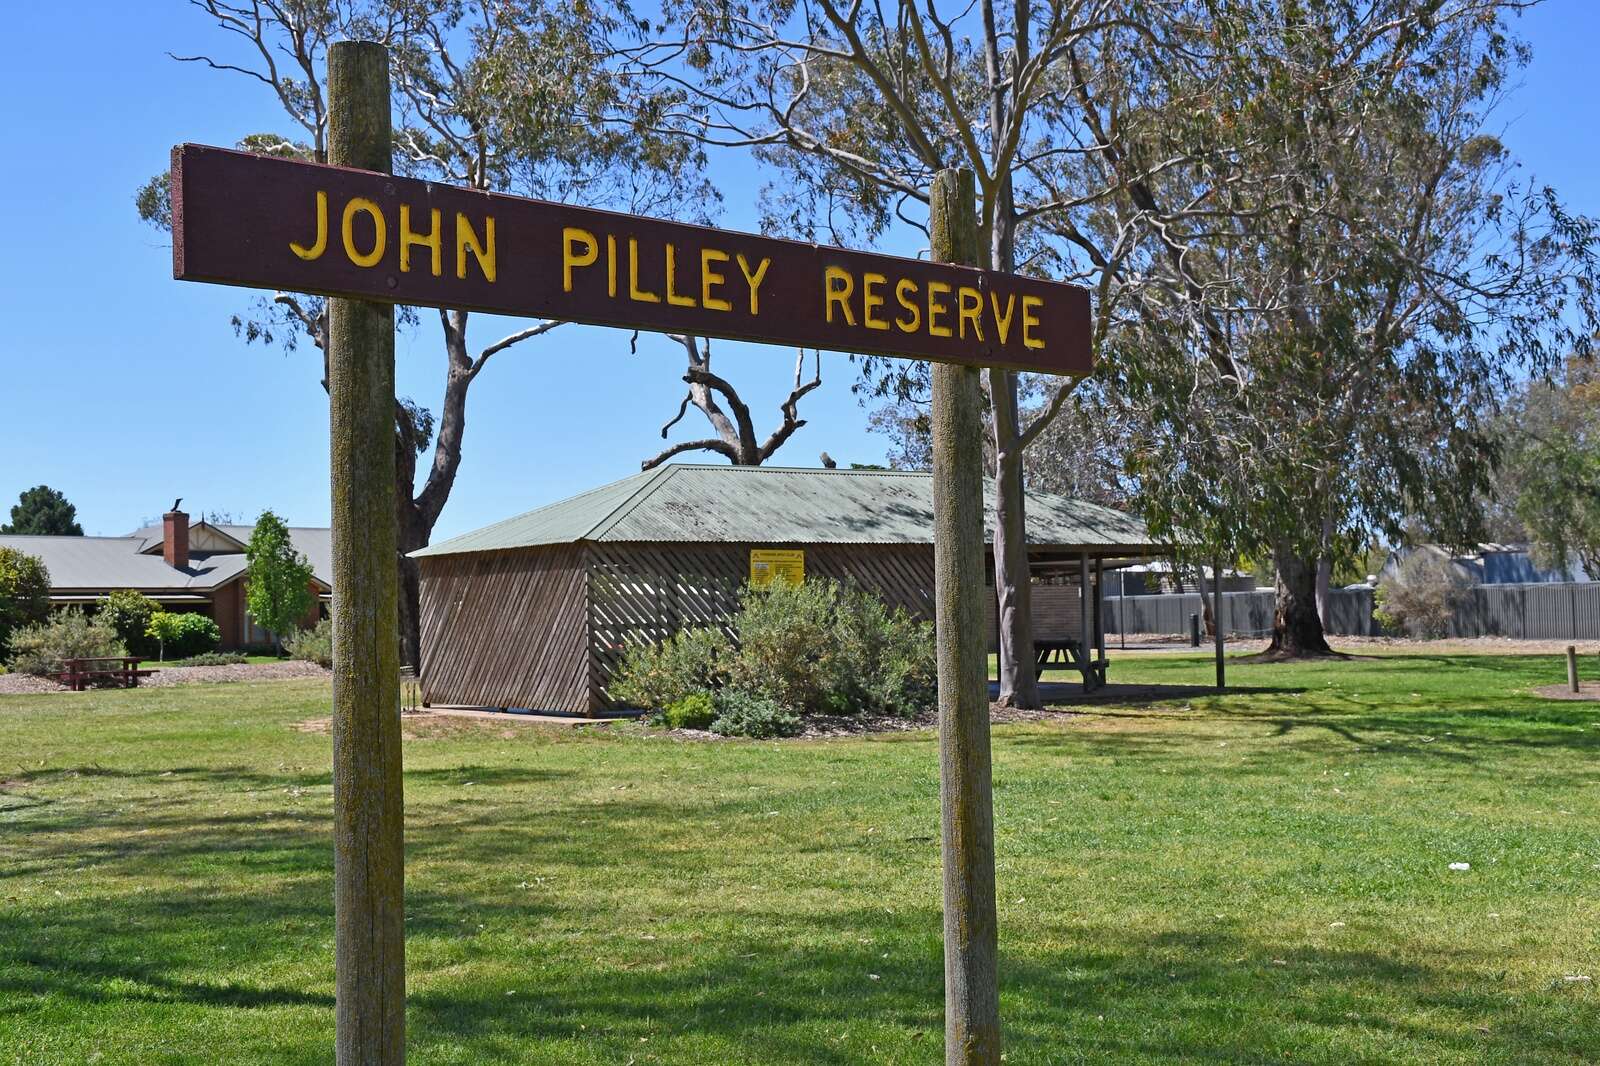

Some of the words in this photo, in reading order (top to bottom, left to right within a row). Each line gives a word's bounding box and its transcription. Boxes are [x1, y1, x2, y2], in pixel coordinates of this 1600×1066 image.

[289, 191, 497, 283] JOHN
[562, 227, 770, 316] PILLEY
[824, 266, 1046, 350] RESERVE
